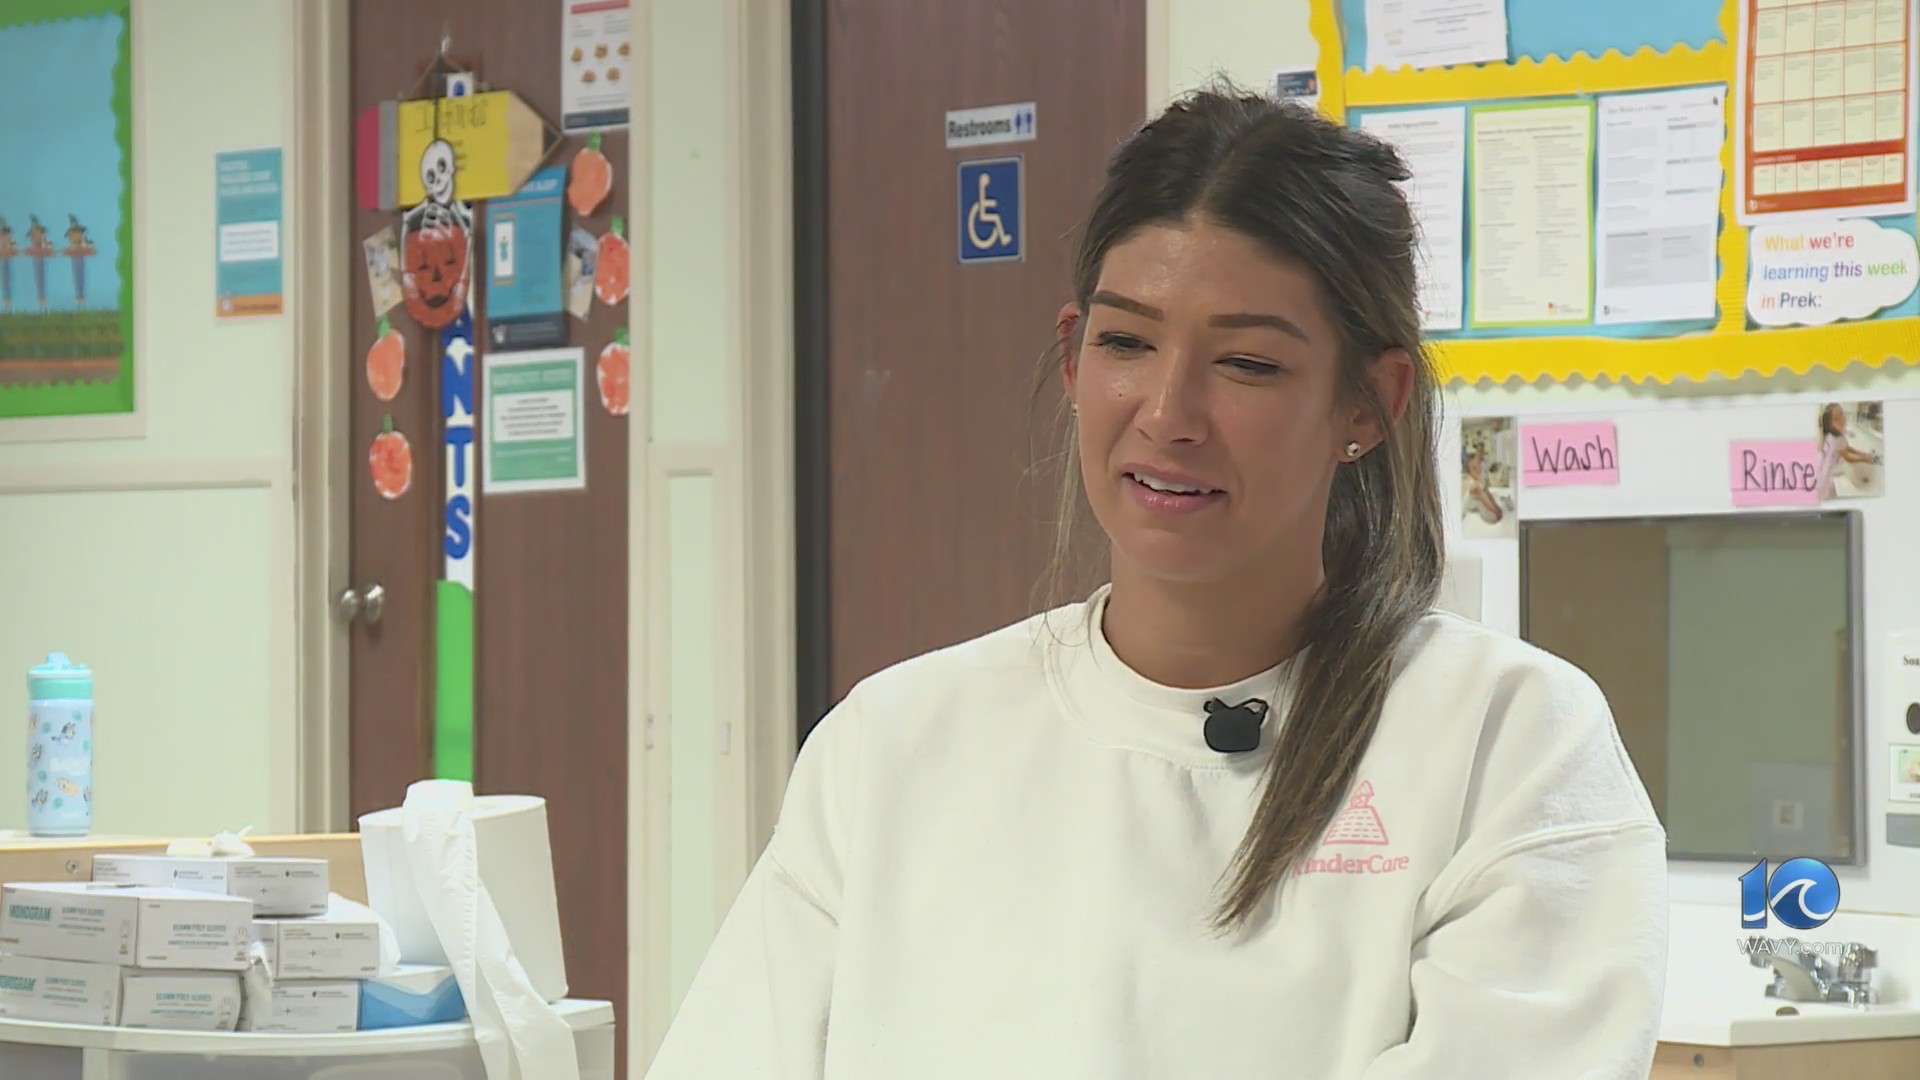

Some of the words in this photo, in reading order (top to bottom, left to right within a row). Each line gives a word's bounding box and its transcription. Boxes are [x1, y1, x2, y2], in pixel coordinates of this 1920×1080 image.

[948, 118, 1012, 138] Restrooms
[1764, 234, 1805, 252] What
[1810, 231, 1855, 249] we're
[1763, 263, 1829, 283] learning
[1833, 261, 1863, 278] this
[1867, 259, 1908, 276] week
[1761, 294, 1775, 309] in
[1779, 291, 1823, 309] Prek:
[1532, 434, 1615, 475] Wash
[1742, 449, 1818, 493] Rinse
